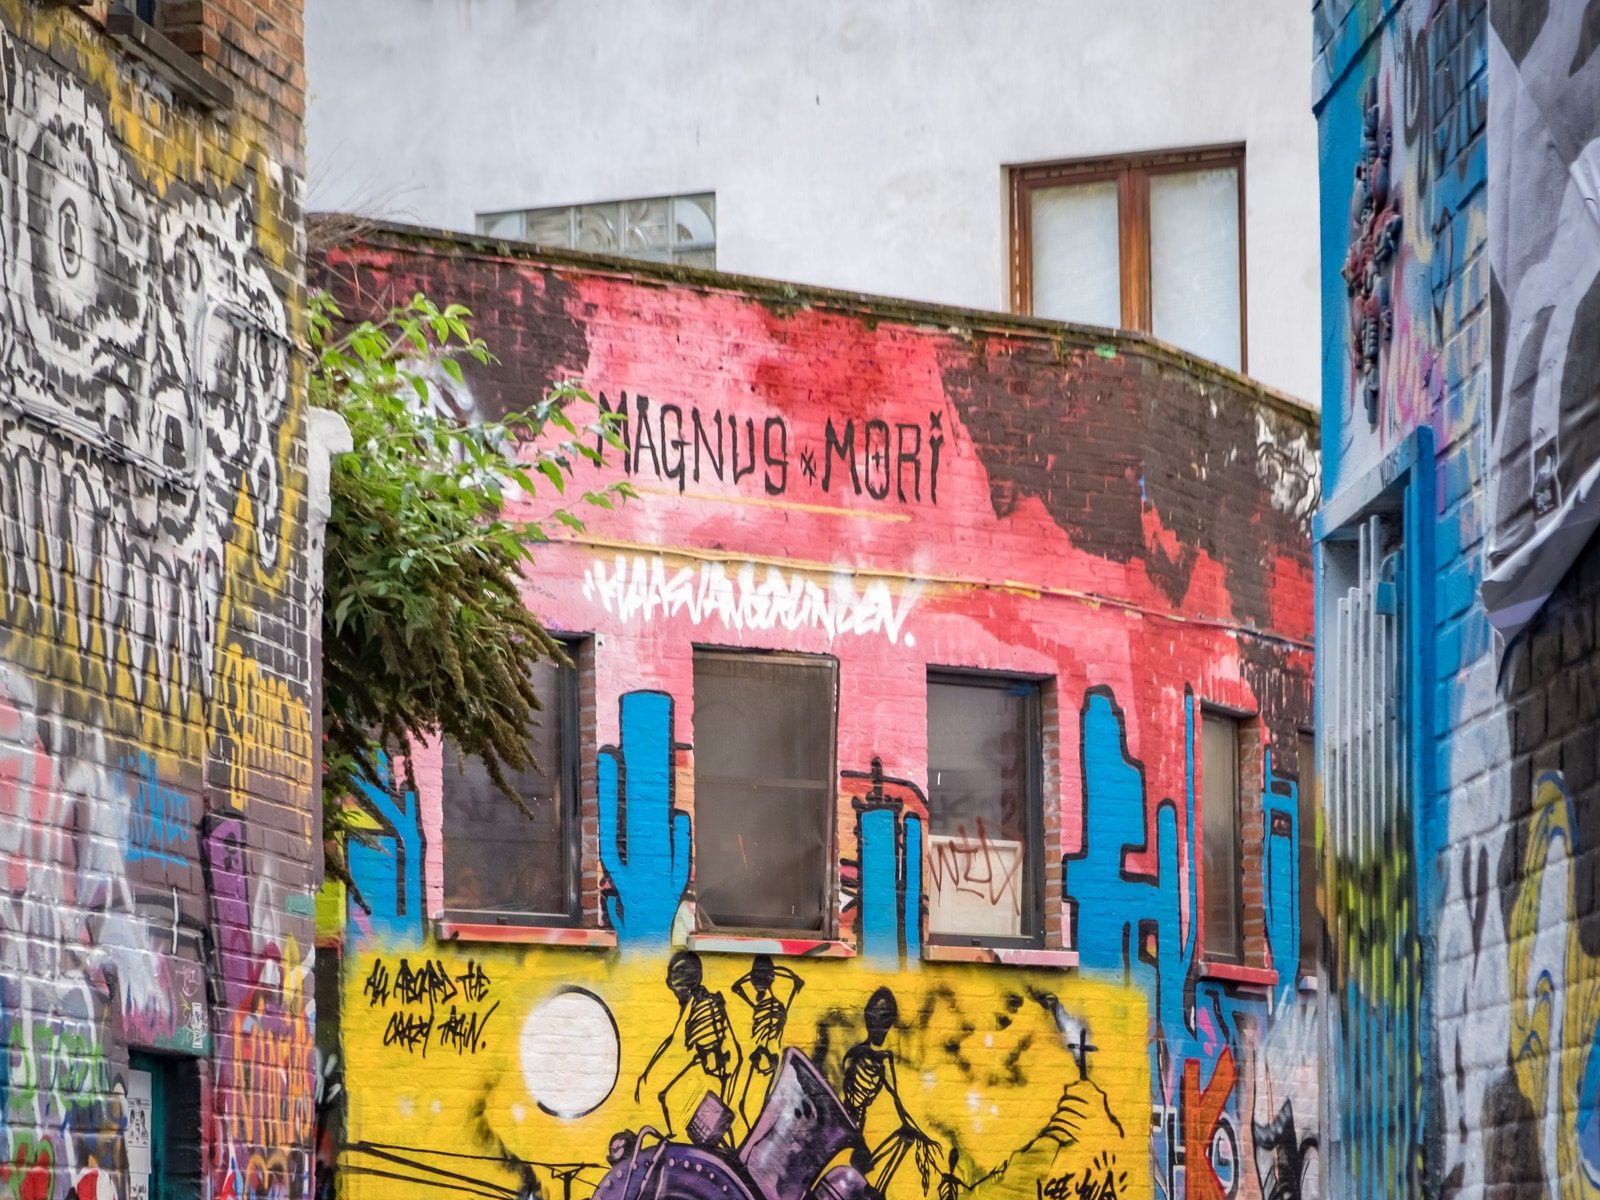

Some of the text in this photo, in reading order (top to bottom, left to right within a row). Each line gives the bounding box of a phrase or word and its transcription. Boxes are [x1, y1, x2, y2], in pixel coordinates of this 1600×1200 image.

[598, 391, 788, 496] MAGNUS
[393, 958, 458, 1007] ABOARD
[455, 958, 491, 1002] THE
